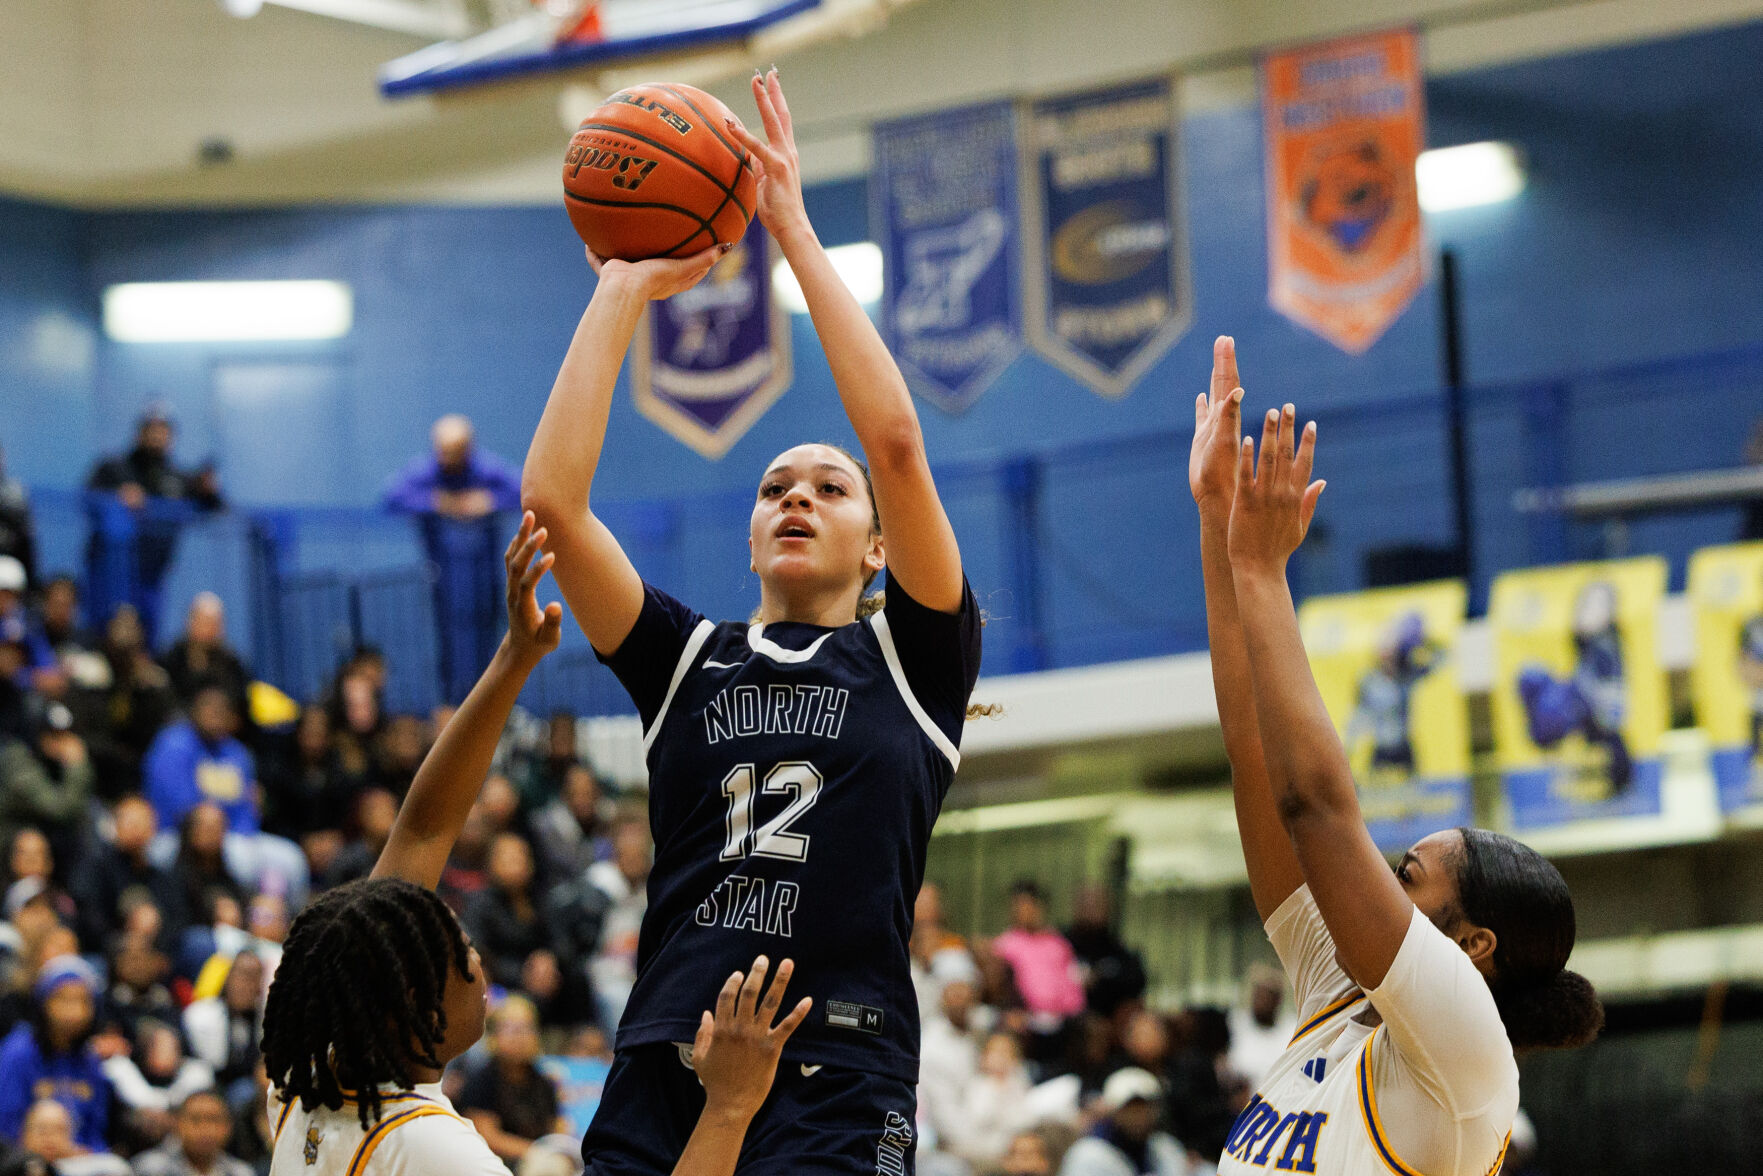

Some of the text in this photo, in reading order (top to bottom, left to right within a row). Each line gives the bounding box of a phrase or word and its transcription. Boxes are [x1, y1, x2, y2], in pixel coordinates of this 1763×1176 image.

[703, 684, 849, 744] NORTH
[719, 761, 824, 863] 12
[695, 874, 800, 938] STAR
[866, 1012, 878, 1027] M
[875, 1111, 912, 1176] ORS
